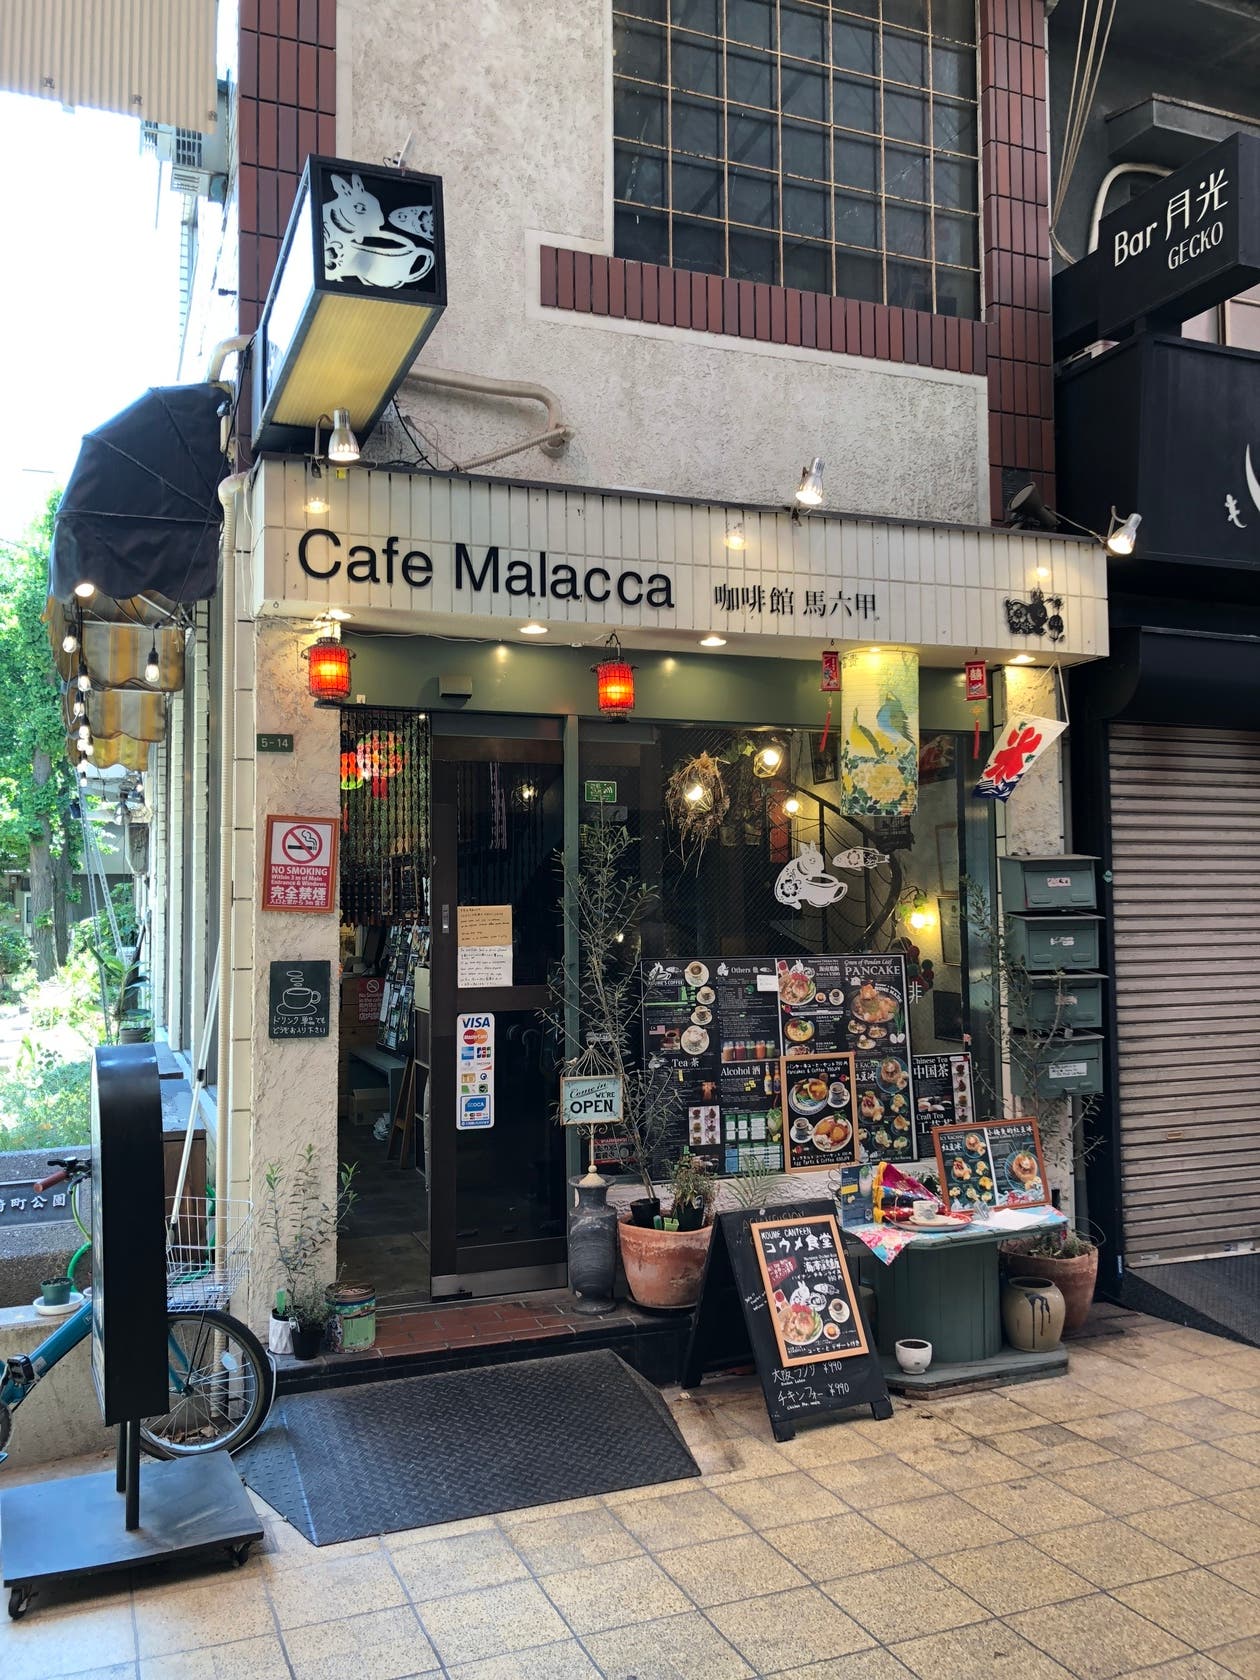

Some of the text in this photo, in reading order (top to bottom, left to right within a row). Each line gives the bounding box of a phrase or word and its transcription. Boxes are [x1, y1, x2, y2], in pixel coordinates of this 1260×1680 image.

[1114, 168, 1229, 267] Bar 月光
[1168, 221, 1224, 270] GECKO
[298, 528, 675, 608] Cafe Malacca
[714, 583, 876, 620] 咖啡館 馬六甲
[261, 737, 289, 748] 5-14
[271, 866, 328, 876] NO SMOKING
[270, 886, 327, 900] 完全禁煙
[845, 965, 900, 976] PANCAKE
[462, 1017, 490, 1028] VISA
[672, 1057, 700, 1068] Tea 茶
[721, 1066, 751, 1076] Alcohol
[913, 1063, 949, 1080] 中国茶
[570, 1087, 596, 1099] Come
[570, 1100, 614, 1114] OPEN
[916, 1112, 944, 1121] Craft Tea
[761, 1226, 812, 1240] KOUME CANTEEN
[764, 1232, 834, 1254] コウメ食堂
[822, 1360, 842, 1374] ¥990
[778, 1382, 850, 1406] チキンフォー ¥990
